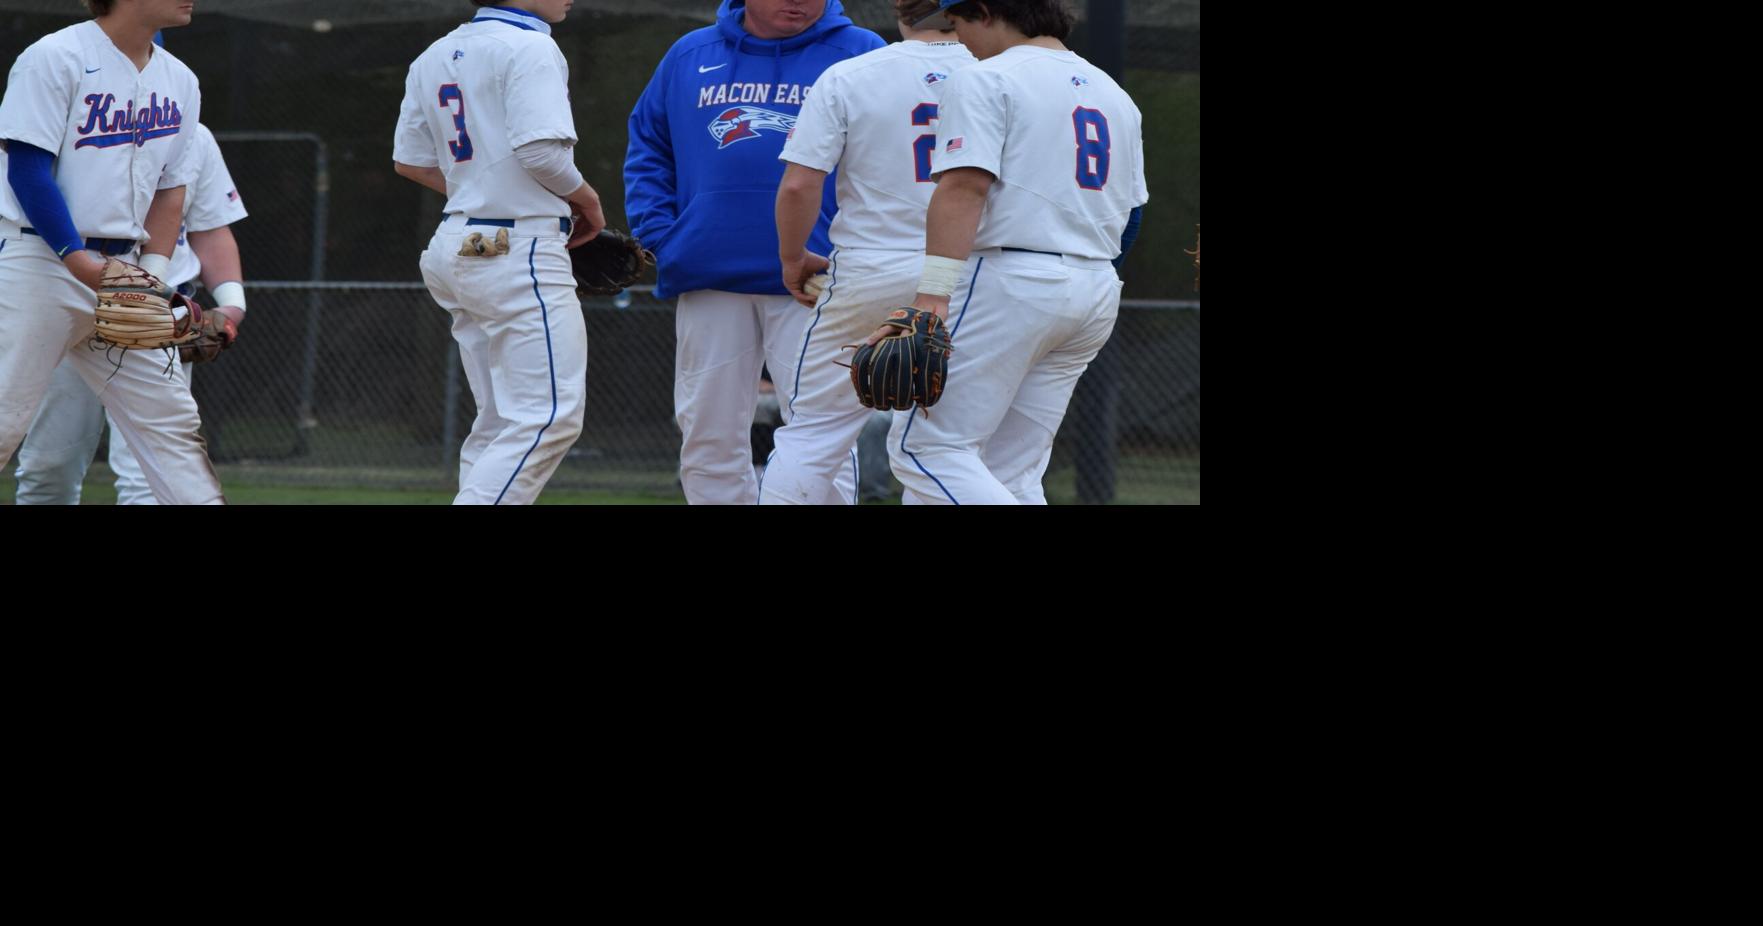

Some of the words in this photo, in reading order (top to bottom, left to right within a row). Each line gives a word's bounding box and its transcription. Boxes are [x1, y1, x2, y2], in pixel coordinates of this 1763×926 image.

[77, 92, 182, 148] Knights
[438, 83, 474, 163] 3
[697, 83, 771, 108] MACON
[1072, 105, 1111, 191] 8
[112, 292, 147, 302] A2000
